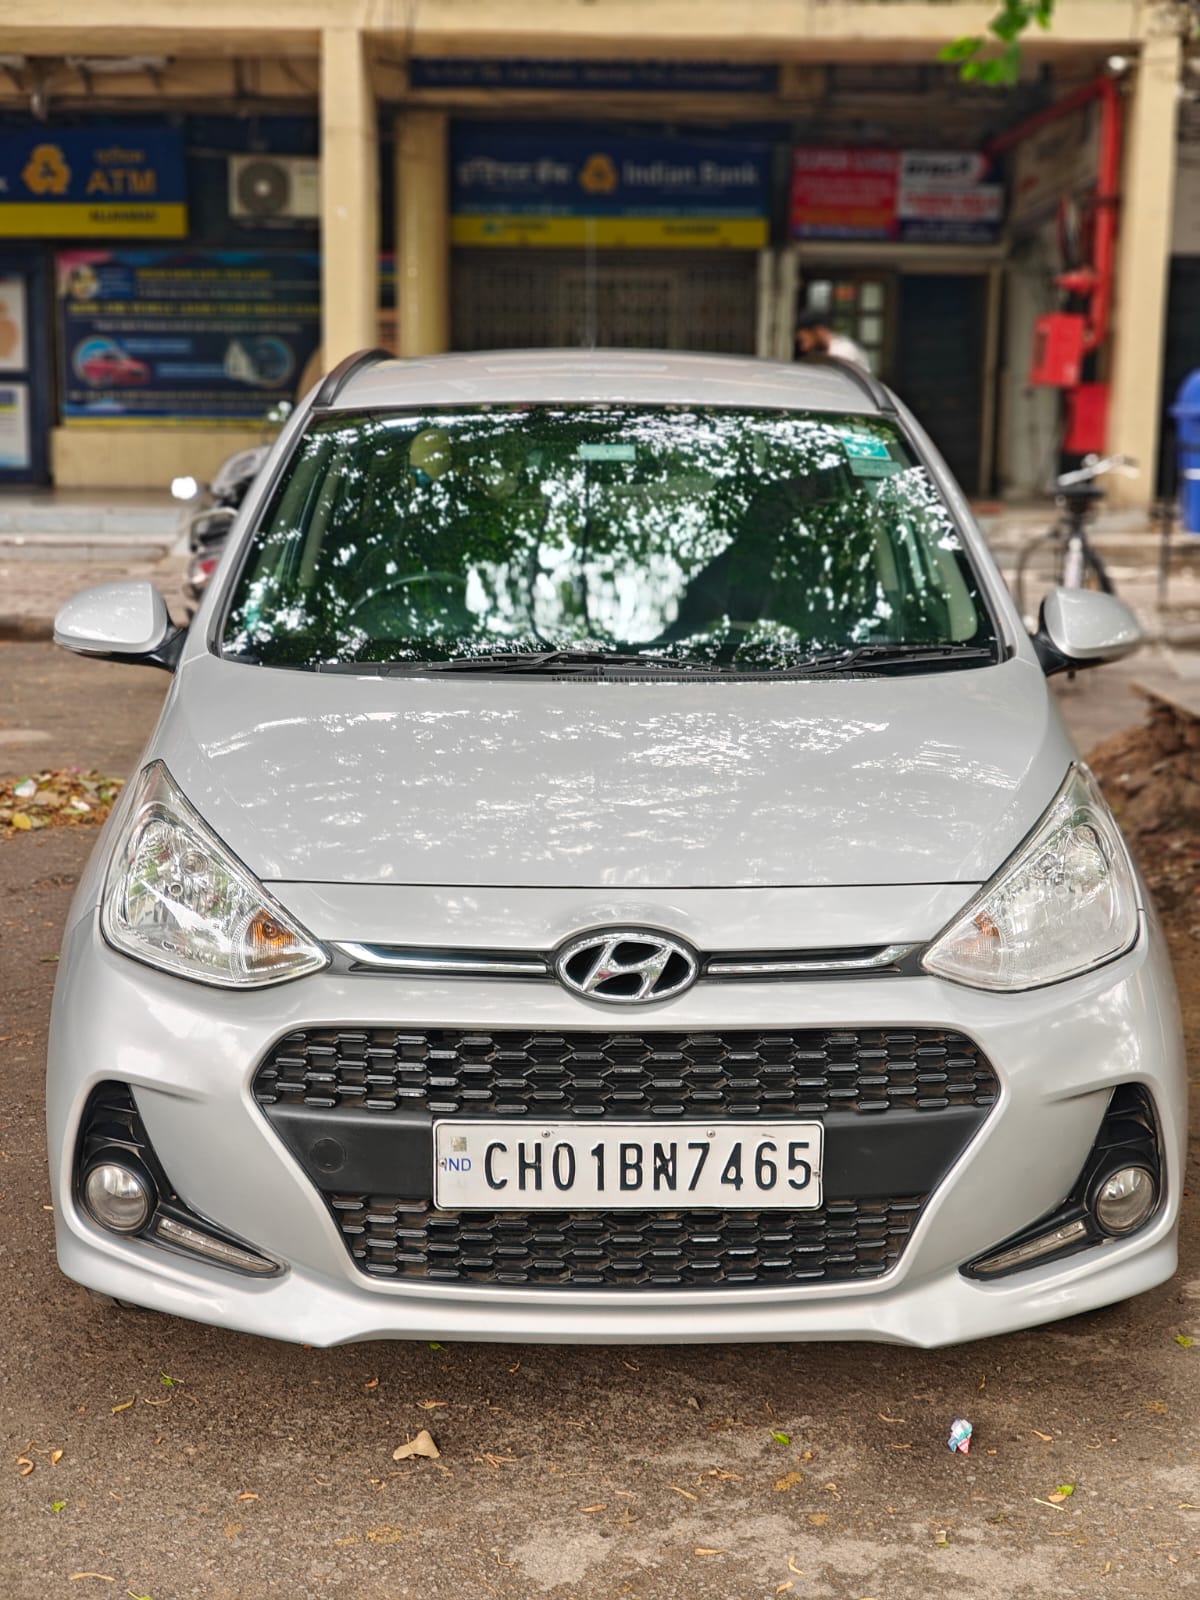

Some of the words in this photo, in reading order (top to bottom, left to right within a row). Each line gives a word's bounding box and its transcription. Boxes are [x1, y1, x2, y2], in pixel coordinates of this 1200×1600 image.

[86, 168, 157, 195] ATM
[623, 160, 696, 186] Indian
[700, 160, 758, 186] Bank
[484, 1142, 812, 1191] CH01BN7465
